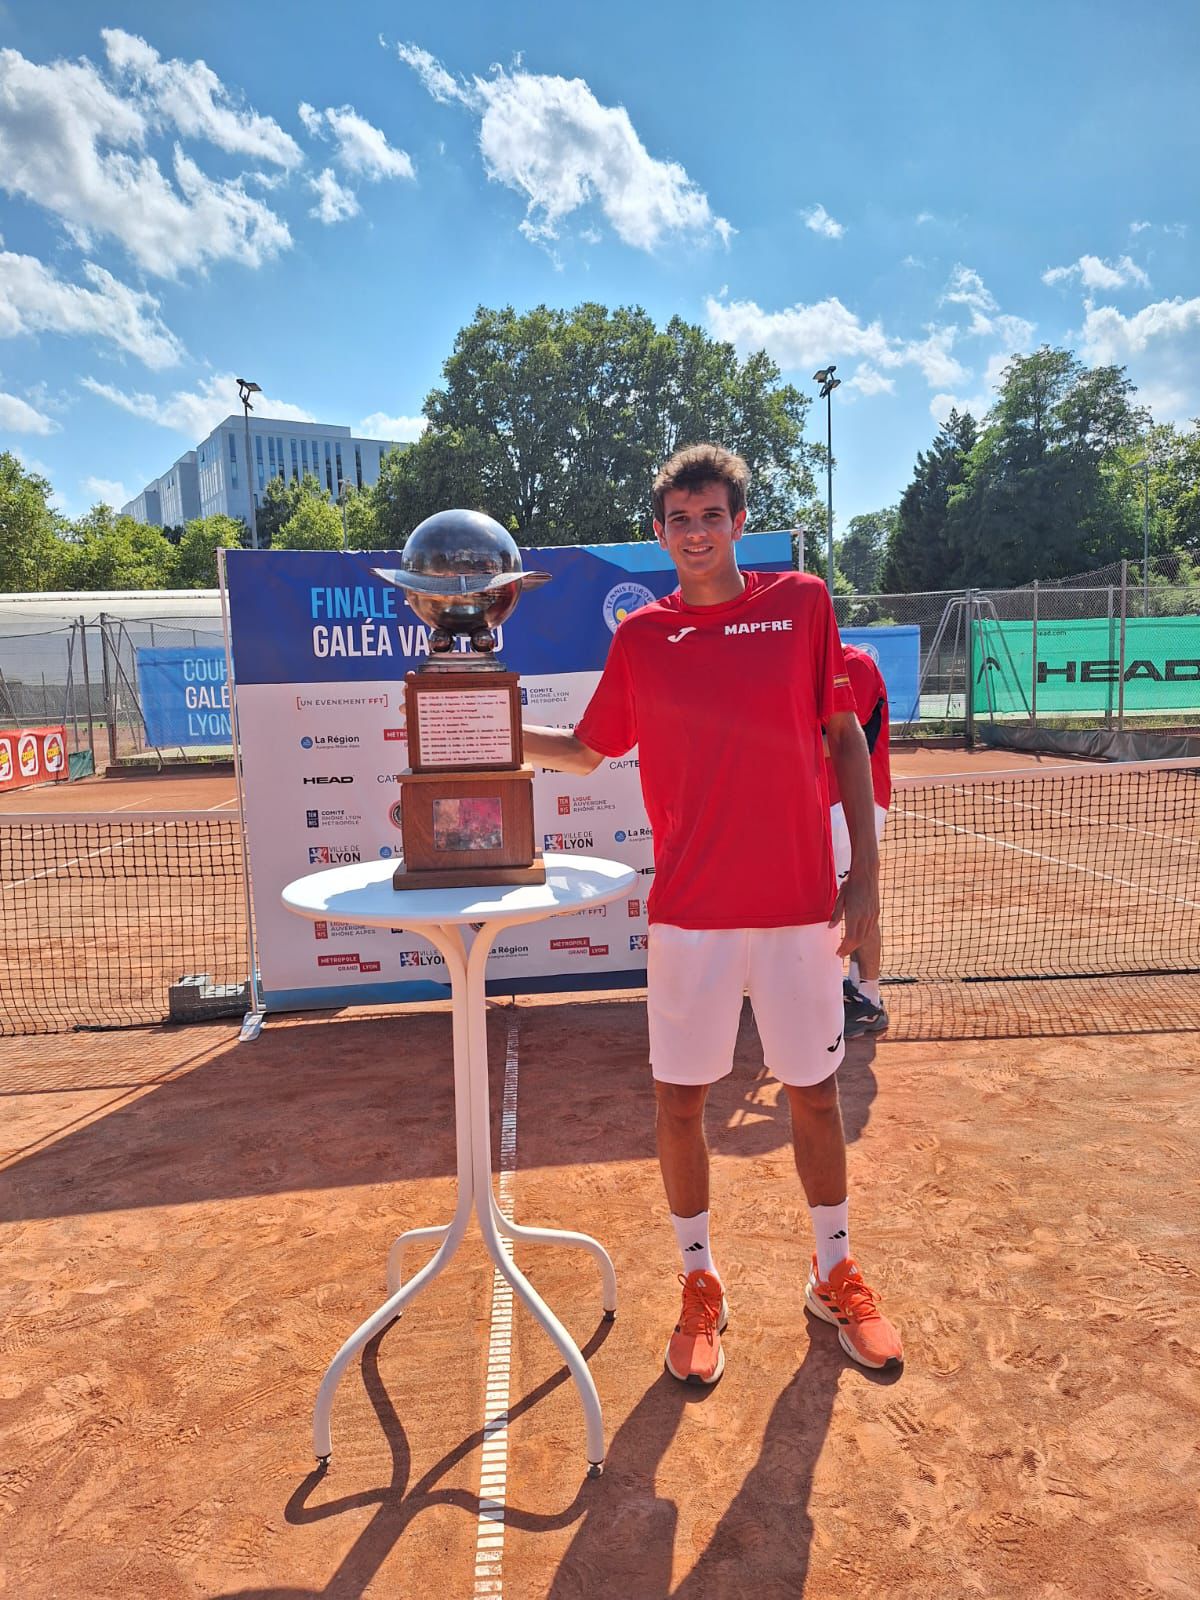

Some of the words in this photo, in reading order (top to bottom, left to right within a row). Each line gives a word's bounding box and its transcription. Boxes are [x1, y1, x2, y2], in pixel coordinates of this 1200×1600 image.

[311, 586, 397, 618] FINALE
[724, 619, 793, 635] MAPFRE
[313, 617, 393, 658] GALÉA
[183, 658, 228, 681] COUP
[1037, 660, 1200, 683] HEAD
[185, 682, 230, 709] GALÉ
[188, 713, 232, 736] LYON
[327, 735, 359, 744] Région
[303, 776, 353, 784] HEAD
[628, 829, 638, 837] La
[564, 838, 593, 849] LYON
[330, 852, 361, 863] LYON
[498, 945, 528, 954] Région
